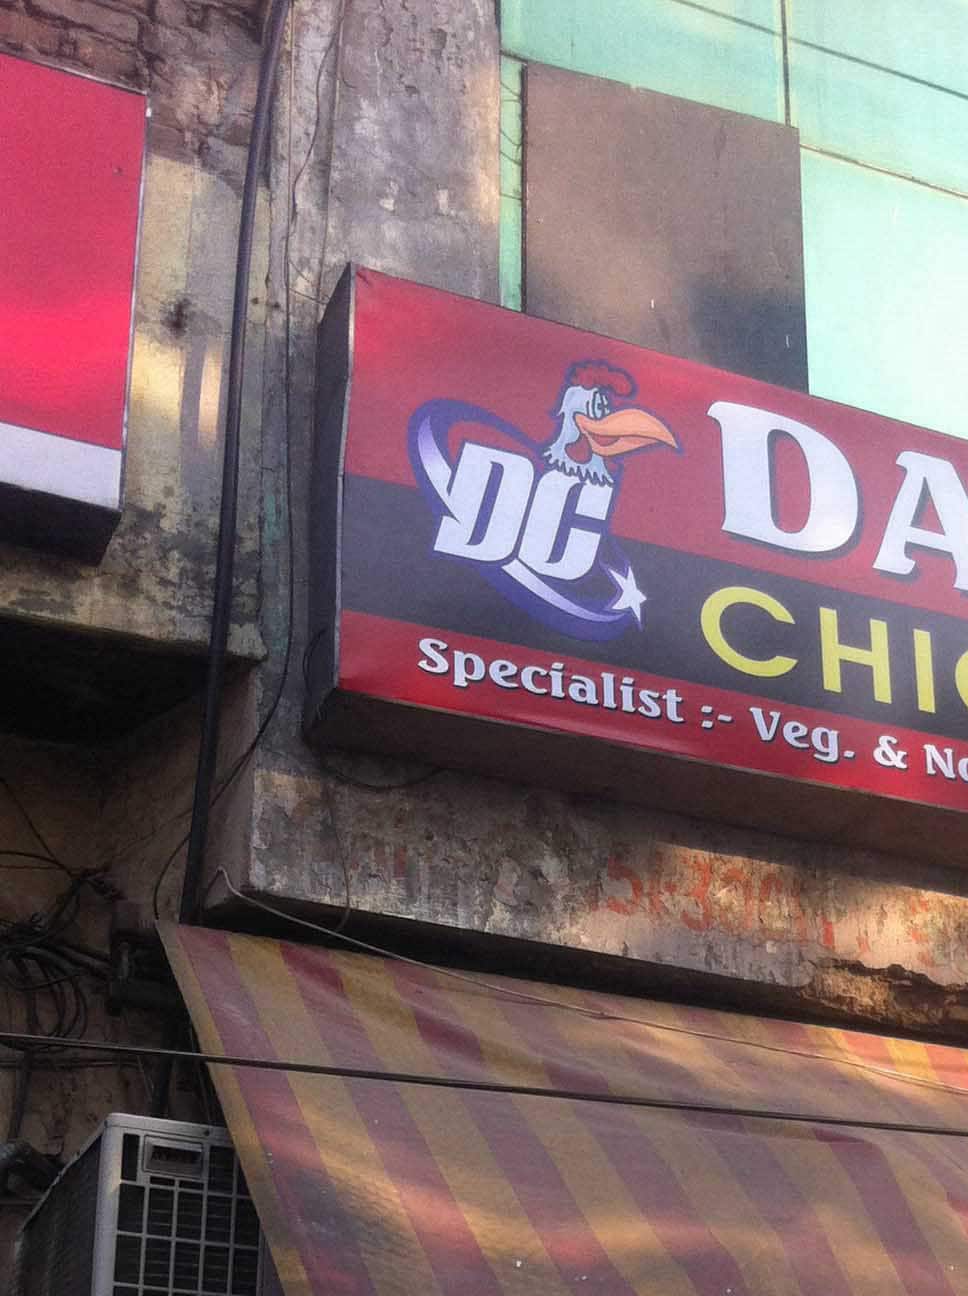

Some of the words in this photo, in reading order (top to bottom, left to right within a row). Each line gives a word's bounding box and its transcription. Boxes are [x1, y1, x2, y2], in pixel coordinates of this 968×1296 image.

[433, 441, 614, 580] DC
[417, 637, 685, 724] Specialist
[749, 707, 856, 763] Veg.
[873, 735, 908, 769] &
